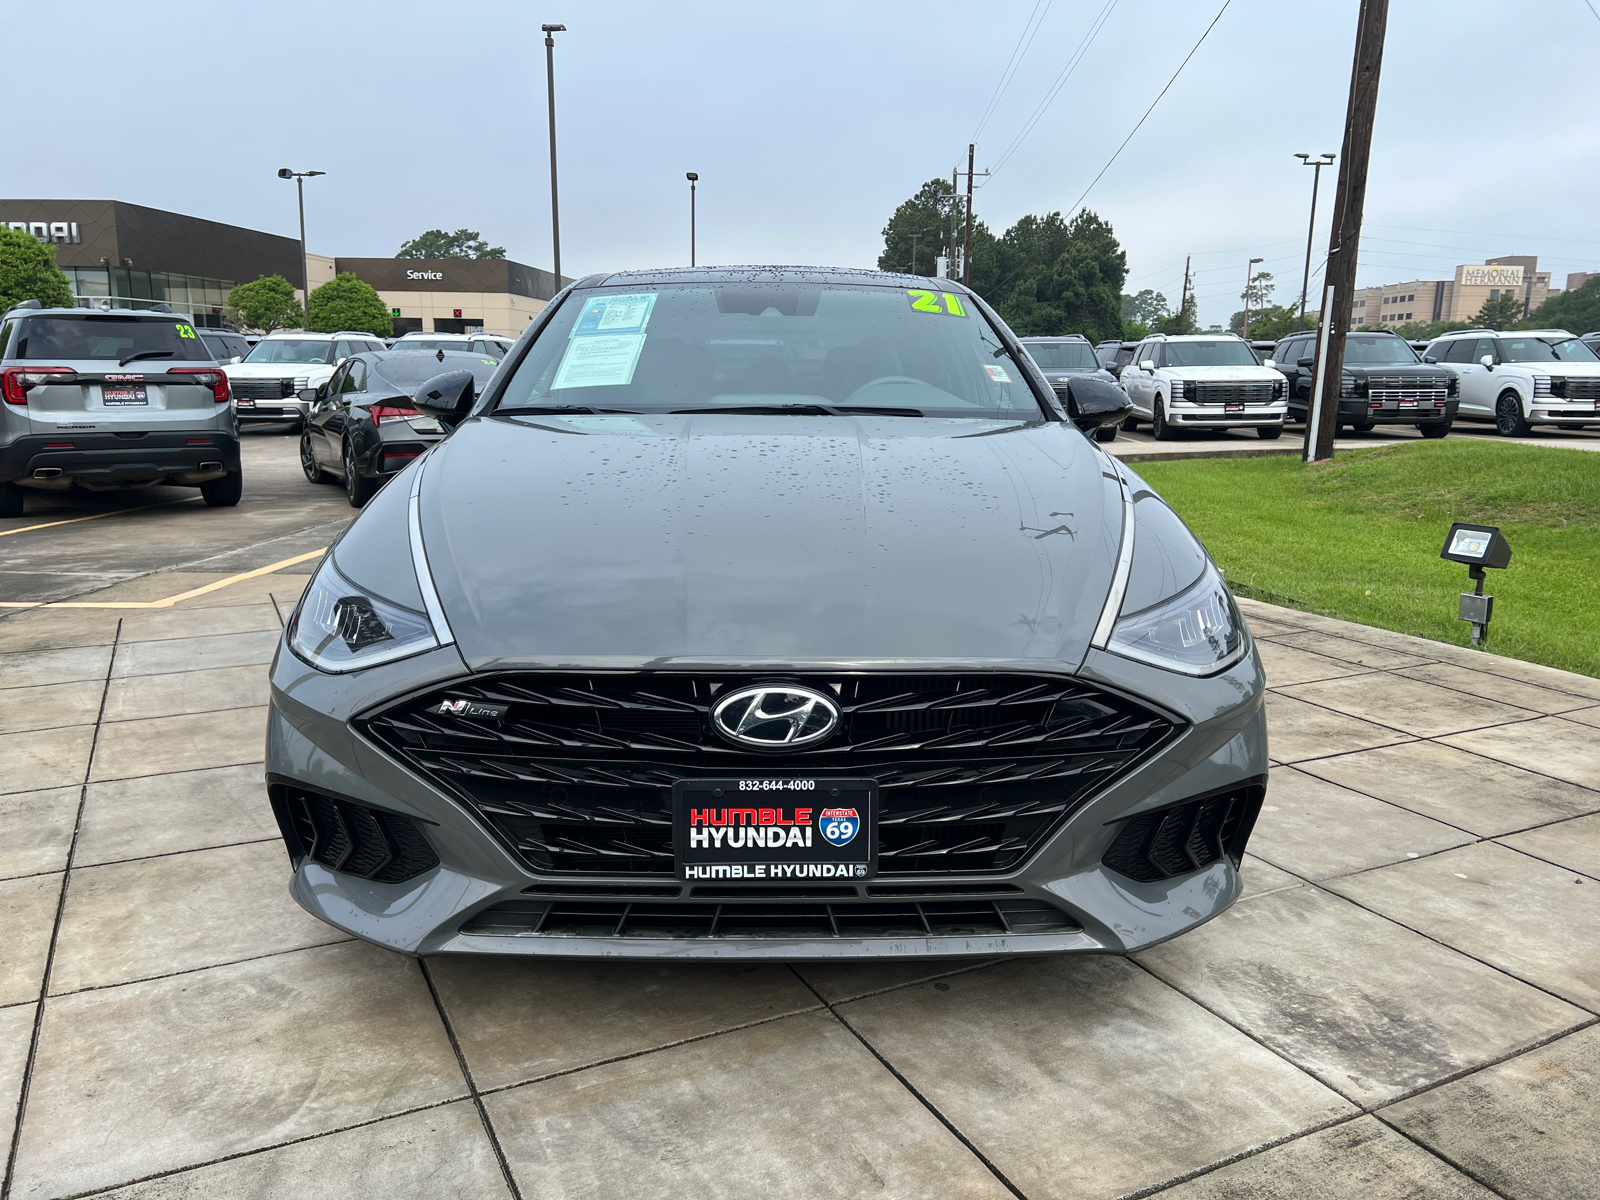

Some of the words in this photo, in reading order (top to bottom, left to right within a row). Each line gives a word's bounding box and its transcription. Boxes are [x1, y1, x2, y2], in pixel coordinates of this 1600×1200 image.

[406, 269, 443, 280] Service
[1465, 276, 1520, 284] HERMANN
[1466, 269, 1521, 278] MEMORIAL
[907, 289, 966, 317] 21
[175, 324, 196, 339] 23
[104, 374, 144, 382] GMC
[738, 780, 816, 791] 832-644-4000
[690, 807, 813, 826] HUMBLE
[690, 827, 813, 848] HYUNDAI
[826, 821, 854, 840] 69
[685, 865, 766, 879] HUMBLE
[770, 864, 854, 877] HYUNDAI
